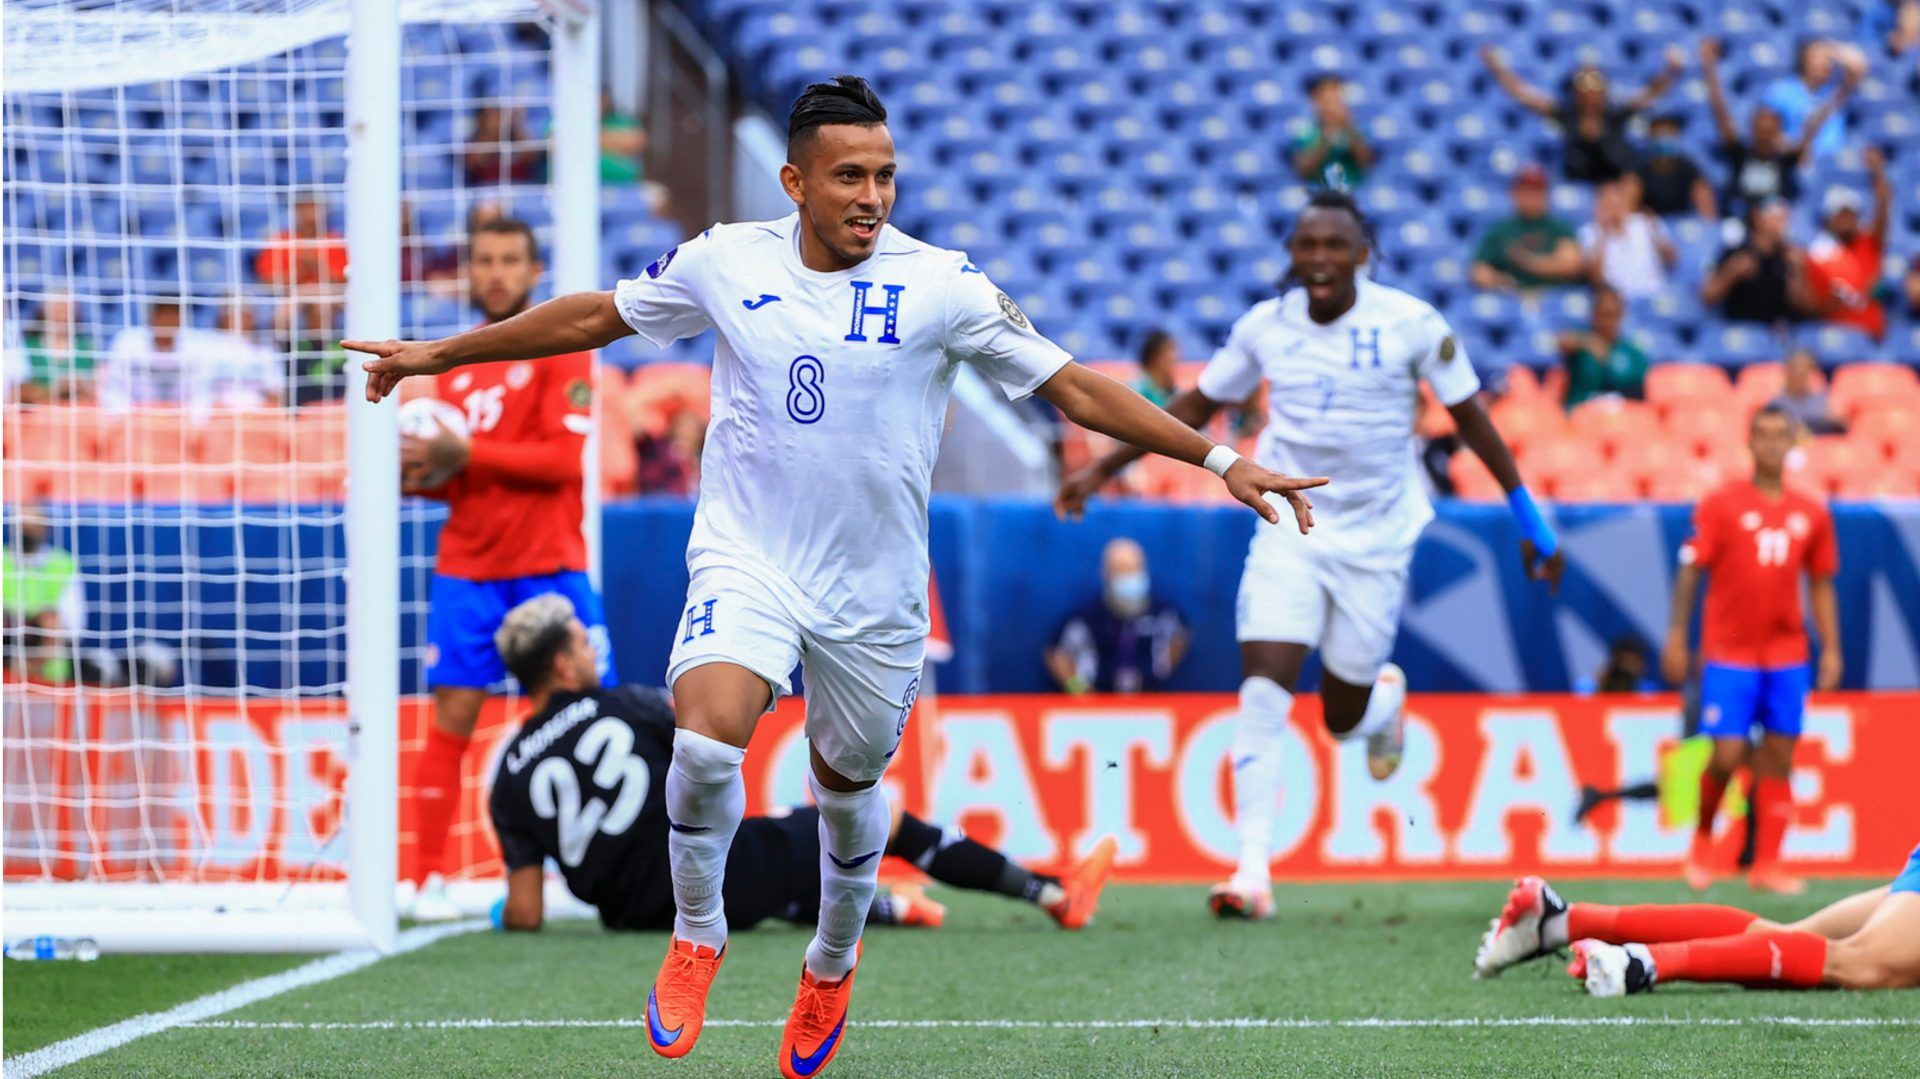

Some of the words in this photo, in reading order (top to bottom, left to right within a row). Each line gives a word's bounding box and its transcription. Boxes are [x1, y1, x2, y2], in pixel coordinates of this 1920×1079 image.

[844, 281, 905, 344] H
[853, 288, 864, 335] HONDURAS
[1349, 326, 1381, 369] H
[463, 383, 507, 433] 15
[786, 354, 825, 425] 8
[1754, 526, 1790, 567] 11
[682, 598, 718, 645] H
[528, 715, 651, 868] 23
